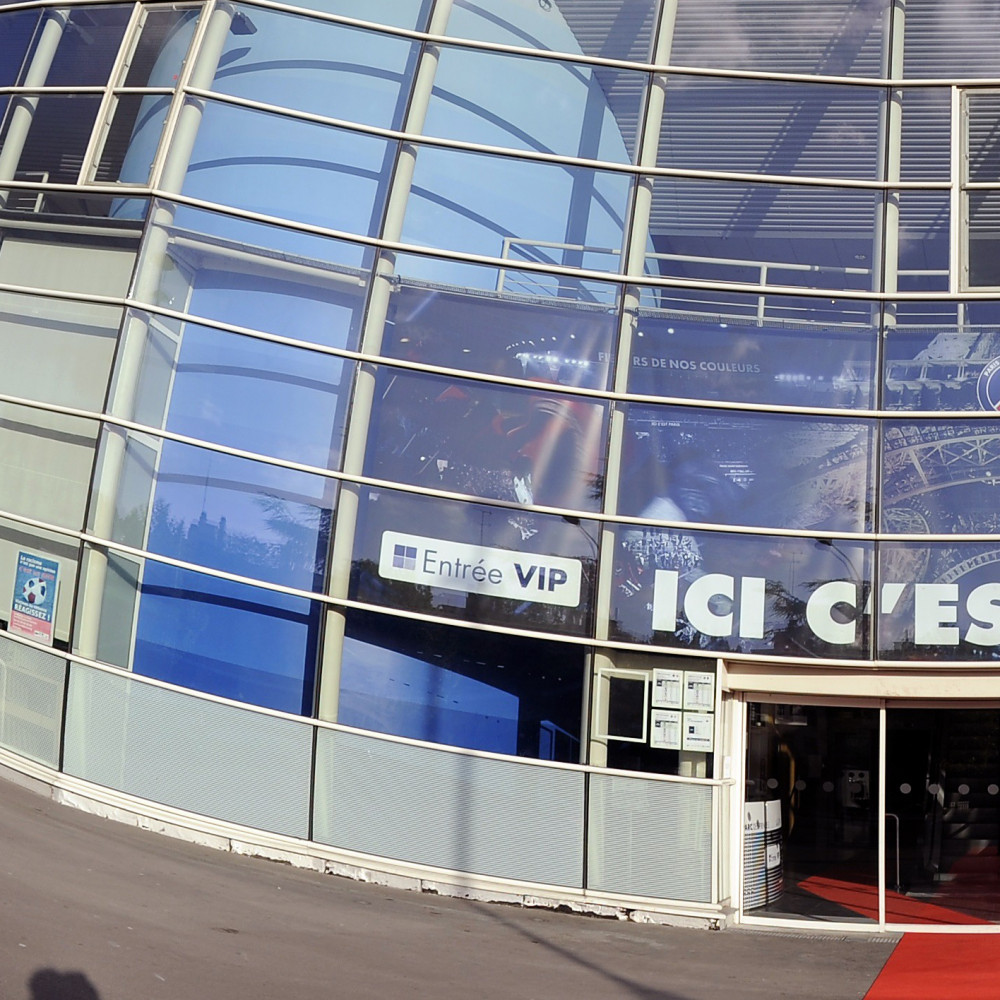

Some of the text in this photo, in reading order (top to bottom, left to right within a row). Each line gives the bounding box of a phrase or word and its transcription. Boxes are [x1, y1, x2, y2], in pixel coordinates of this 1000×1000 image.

[651, 357, 667, 368] DE
[669, 359, 697, 370] NOS
[699, 361, 761, 373] COULEURS
[984, 360, 1000, 377] PARIS
[422, 549, 568, 592] Entrée VIP
[652, 569, 766, 639] ICI
